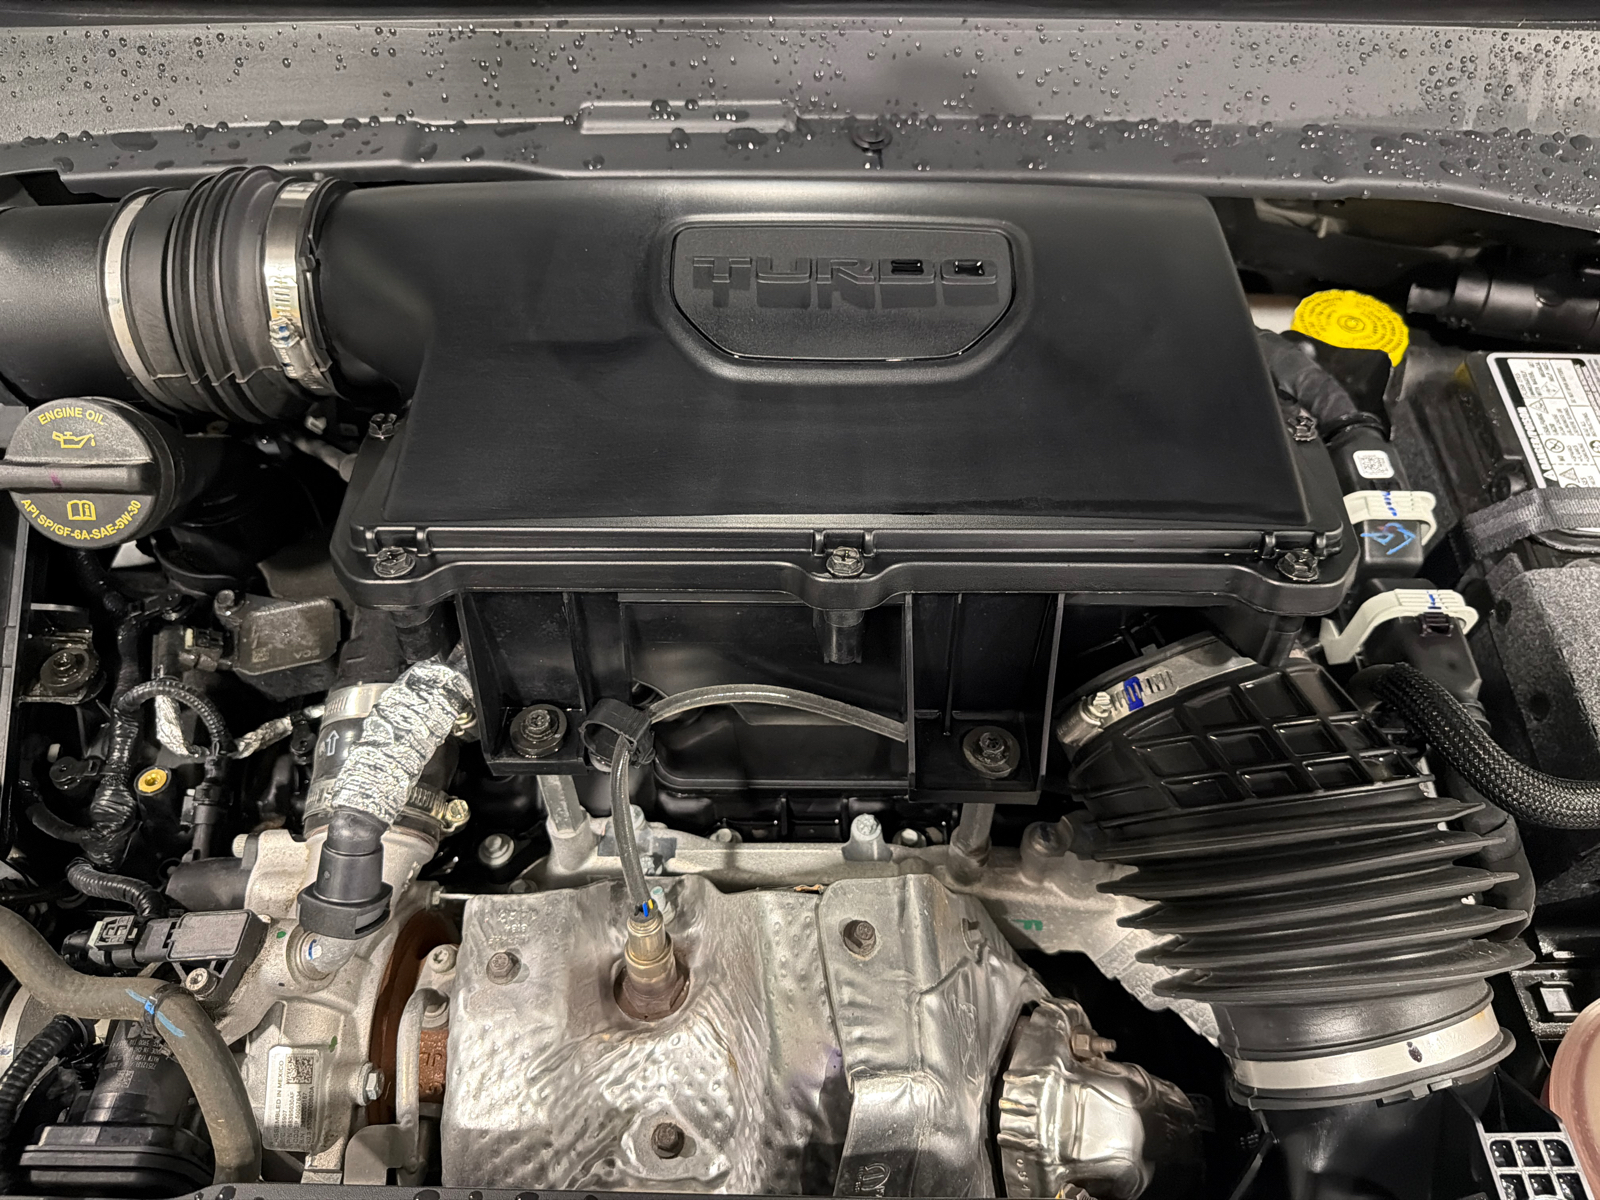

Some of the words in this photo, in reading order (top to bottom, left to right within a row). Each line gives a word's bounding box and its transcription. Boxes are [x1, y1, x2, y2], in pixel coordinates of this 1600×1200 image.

[693, 256, 998, 289] TURBO
[38, 406, 83, 425] ENGINE
[85, 409, 106, 425] OIL
[21, 498, 37, 518] API
[37, 499, 142, 541] SP/GF-6A-SAE-5W-30
[276, 1089, 281, 1097] IN
[273, 1099, 282, 1142] ASSEMBLED
